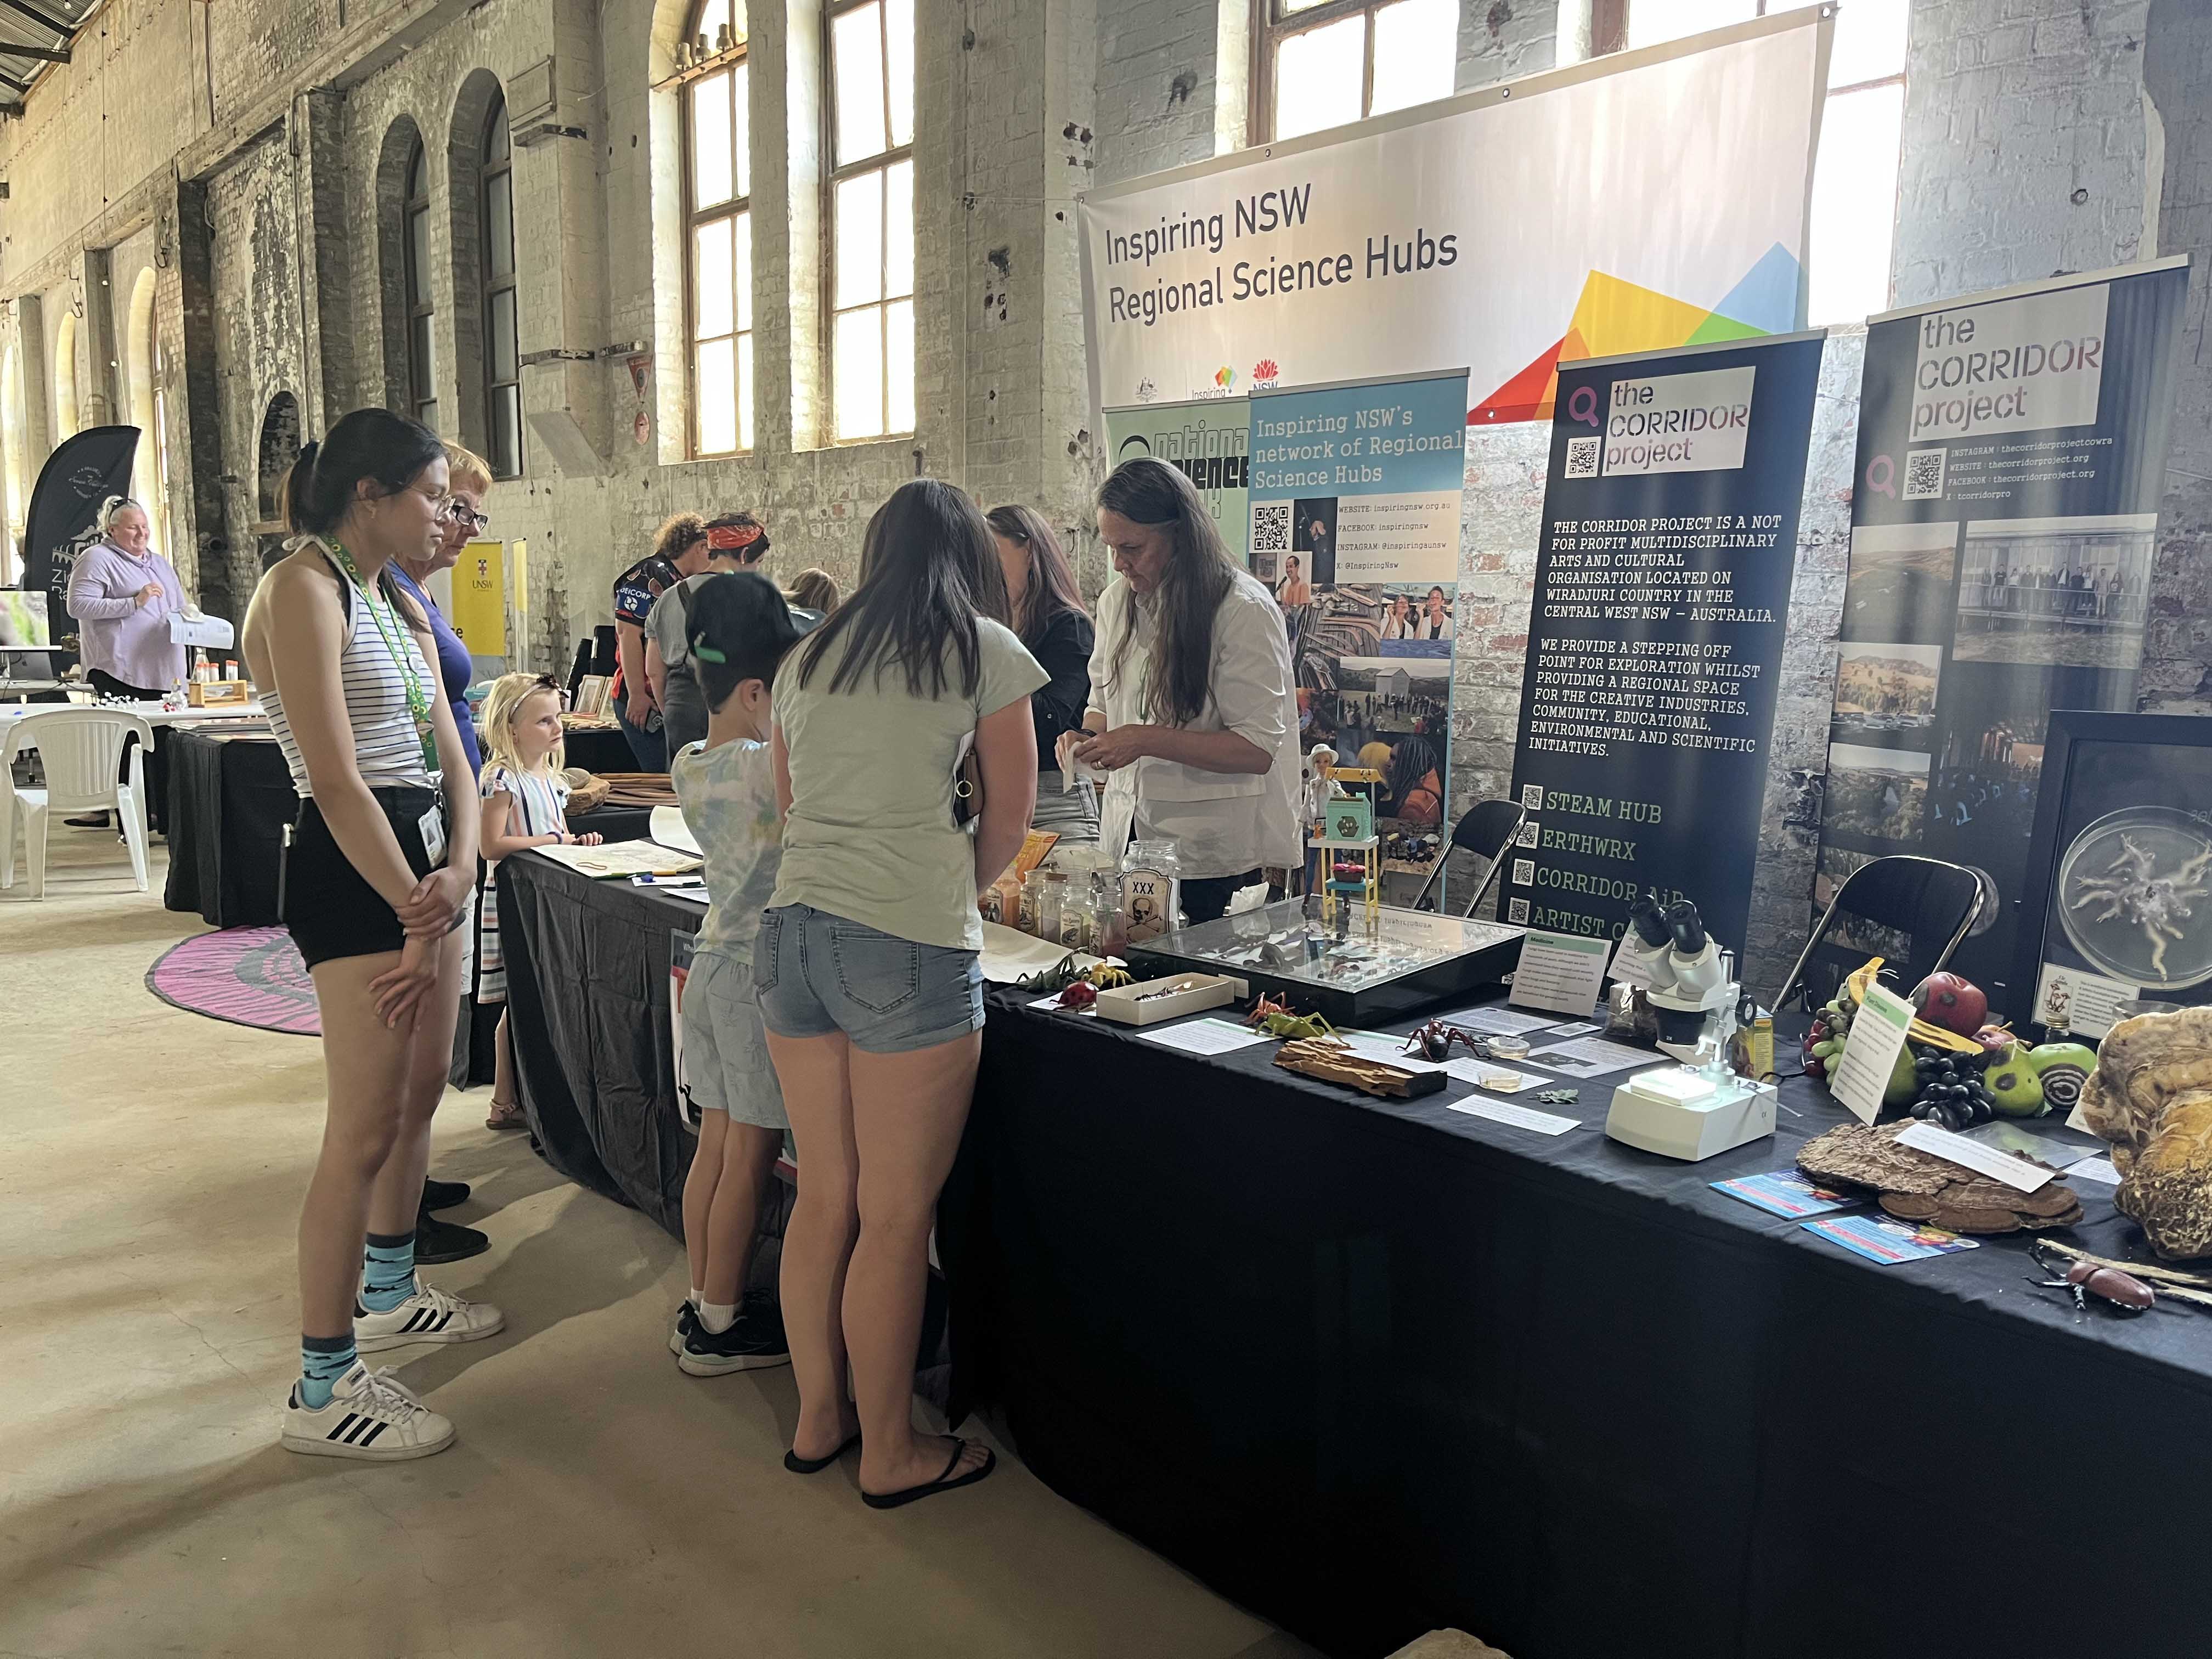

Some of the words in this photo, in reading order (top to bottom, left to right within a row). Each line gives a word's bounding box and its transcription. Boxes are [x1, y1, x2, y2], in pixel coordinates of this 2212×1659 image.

[1106, 211, 1223, 267] Inspiring
[1235, 183, 1312, 238] NSW
[1109, 267, 1224, 326] Regional
[1232, 252, 1353, 301] Science
[1365, 228, 1458, 279] Hubs
[1925, 315, 1975, 349] the
[1918, 336, 2101, 390] CORRIDOR
[1192, 387, 1226, 400] Inspiring
[1614, 382, 1654, 408] the
[1256, 414, 1347, 438] Inspiring
[1355, 407, 1414, 428] NSW's
[1609, 403, 1748, 438] CORRIDOR
[1914, 386, 2028, 437] project
[1154, 419, 1250, 460] nationa
[1255, 442, 1334, 464] network
[1340, 438, 1362, 457] of
[1369, 430, 1464, 456] Regional
[1951, 446, 1994, 457] INSTAGRAM
[2001, 438, 2113, 453] thecorridorprojectcowra
[1606, 438, 1694, 471] project
[1949, 462, 1982, 472] WEBSITE
[1170, 456, 1249, 489] ience
[1255, 465, 1328, 489] Science
[1334, 465, 1383, 484] Hubs
[1948, 476, 1987, 487] FACEBOOK
[1379, 522, 1429, 531] inspiringnsw
[1554, 521, 1578, 534] THE
[1581, 519, 1647, 533] CORRIDOR
[1650, 517, 1712, 532] PROJECT
[1716, 516, 1731, 530] IS
[1735, 516, 1746, 529] A
[1751, 515, 1782, 529] NOT
[1551, 537, 1577, 551] FOR
[1579, 536, 1627, 550] PROFIT
[1630, 533, 1778, 549] MULTIDISCIPLINARY
[1549, 554, 1582, 567] ARTS
[1584, 554, 1611, 567] AND
[1613, 554, 1685, 567] CULTURAL
[472, 580, 493, 589] UNSW
[1548, 571, 1641, 585] ORGANISATION
[1645, 571, 1708, 585] LOCATED
[1712, 571, 1732, 585] ON
[1546, 588, 1616, 602] WIRADJURI
[1619, 589, 1683, 603] COUNTRY
[1685, 589, 1702, 603] IN
[1705, 589, 1734, 603] THE
[1544, 605, 1600, 619] CENTRAL
[1604, 606, 1639, 619] WEST
[1641, 607, 1671, 620] NSW
[1689, 608, 1776, 623] AUSTRALIA.
[1541, 639, 1558, 652] WE
[1560, 639, 1616, 653] PROVIDE
[1618, 641, 1628, 654] A
[1632, 641, 1699, 658] STEPPING
[1703, 644, 1731, 658] OFF
[1538, 655, 1576, 669] POINT
[1578, 657, 1604, 670] FOR
[1607, 658, 1700, 675] EXPLORATION
[1705, 662, 1760, 679] WHILST
[1536, 672, 1605, 688] PROVIDING
[1607, 675, 1617, 689] A
[1621, 676, 1689, 693] REGIONAL
[1693, 680, 1740, 696] SPACE
[1534, 688, 1559, 702] FOR
[1561, 690, 1585, 704] THE
[1589, 691, 1655, 708] CREATIVE
[1658, 696, 1749, 716] INDUSTRIES,
[1532, 704, 1610, 724] COMMUNITY,
[1614, 710, 1712, 731] EDUCATIONAL,
[1528, 737, 1609, 757] INITIATIVES.
[1530, 721, 1635, 742] ENVIRONMENTAL
[1638, 730, 1668, 744] AND
[1671, 732, 1756, 753] SCIENTIFIC
[1545, 791, 1612, 817] STEAM
[1618, 803, 1662, 824] HUB
[1542, 829, 1637, 861] ERTHWRX
[1133, 882, 1154, 895] XXX
[1537, 867, 1638, 901] CORRIDOR
[1533, 907, 1605, 938] ARTIST
